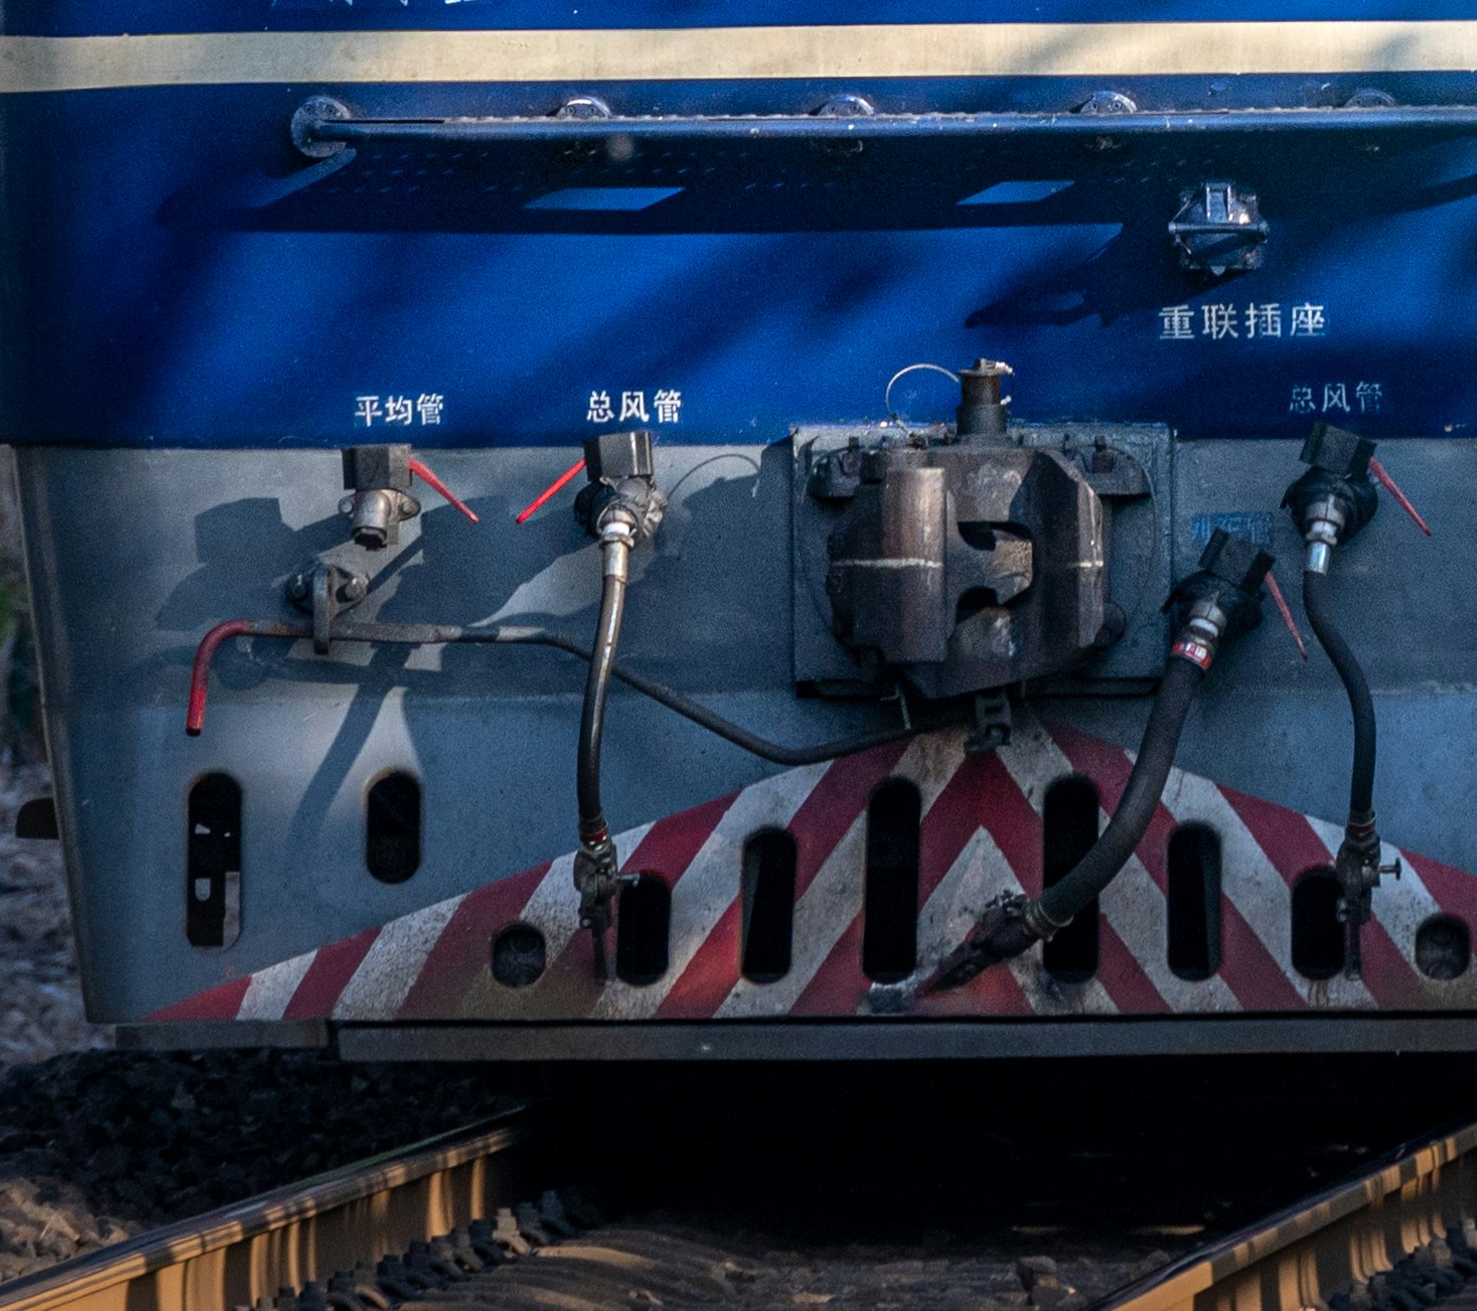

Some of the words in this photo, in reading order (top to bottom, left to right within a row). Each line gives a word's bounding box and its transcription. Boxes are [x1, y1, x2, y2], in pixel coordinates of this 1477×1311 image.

[1158, 302, 1326, 341] 重联插座
[354, 392, 445, 427] 平均管
[586, 388, 682, 424] 总风管
[1288, 380, 1384, 413] 总风管
